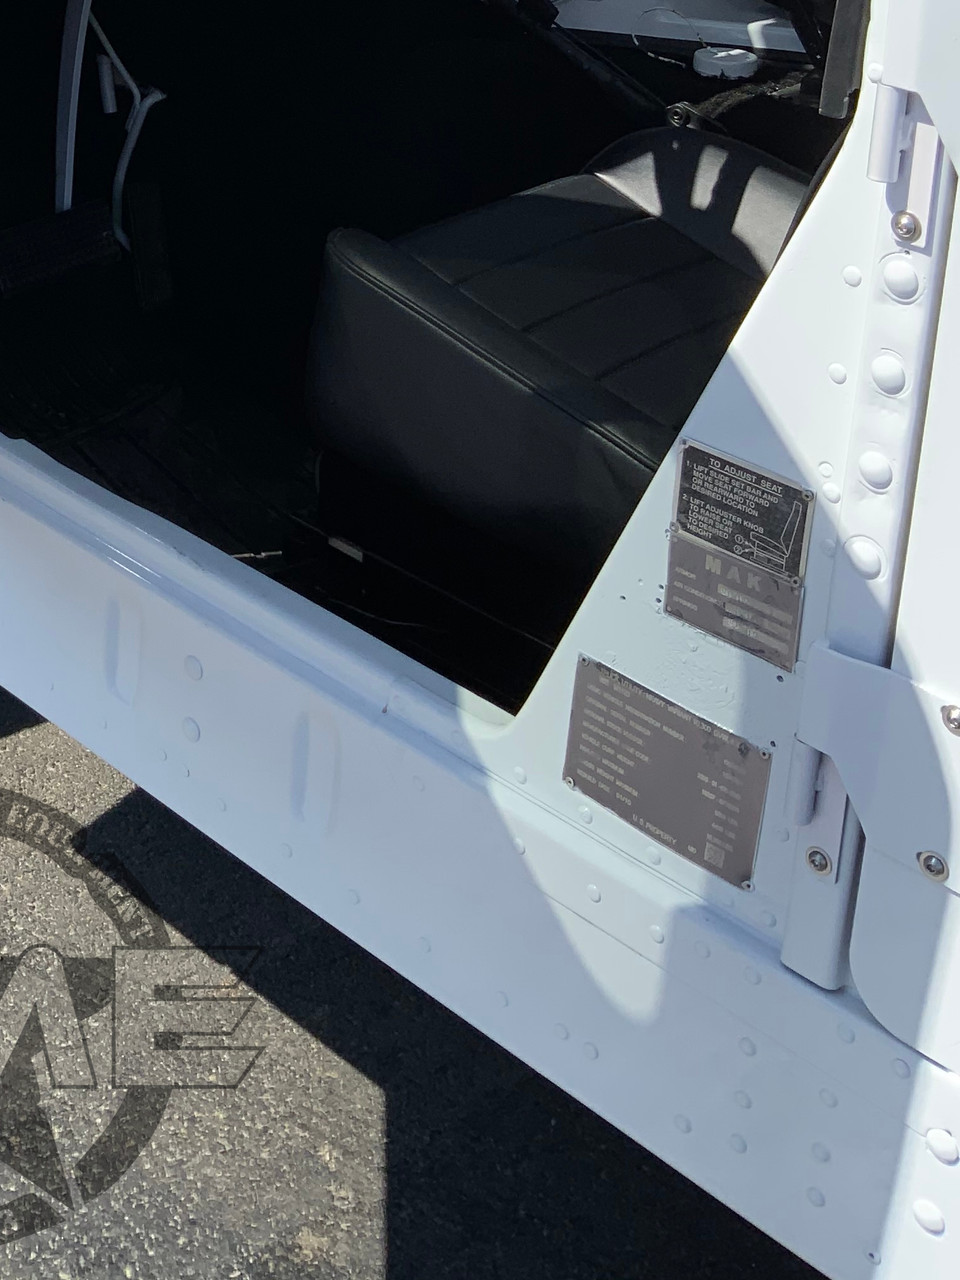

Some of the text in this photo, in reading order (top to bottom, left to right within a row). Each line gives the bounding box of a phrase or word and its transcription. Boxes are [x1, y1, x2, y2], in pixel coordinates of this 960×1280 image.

[693, 463, 708, 474] LIFT
[710, 470, 730, 484] SLIDE
[746, 485, 762, 497] BAR
[763, 493, 779, 504] AND
[693, 470, 770, 507] MOVE SEAT FORWARD
[709, 458, 782, 494] TO ADJUST SEAT
[691, 483, 758, 517] DESIRED LOCATION
[692, 477, 755, 508] OR REARWARD TO
[687, 523, 713, 539] HEIGHT
[688, 516, 729, 539] TO DESIRED
[689, 503, 733, 527] TO RAISE OR
[689, 509, 733, 534] LOWER SEAT
[690, 496, 705, 507] LIFT
[705, 504, 742, 524] ADJUSTER
[743, 520, 764, 534] KNOB
